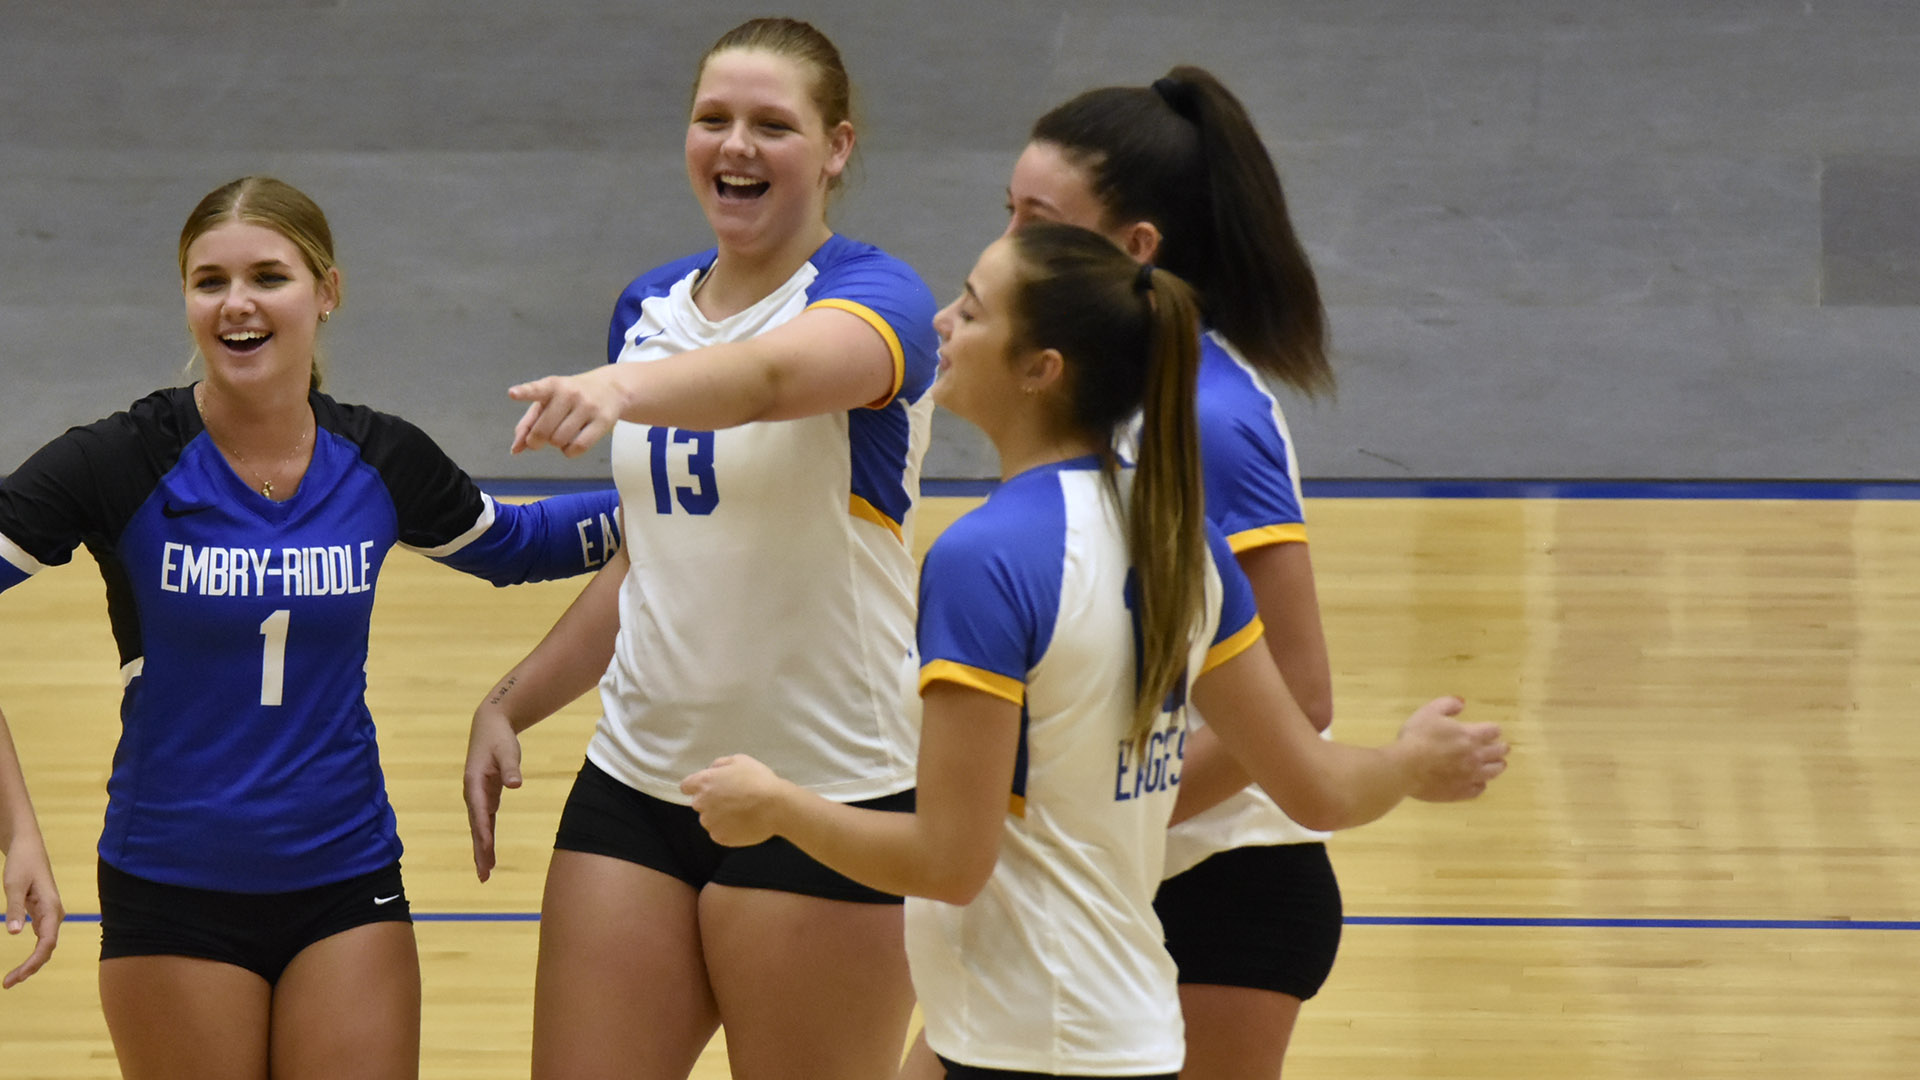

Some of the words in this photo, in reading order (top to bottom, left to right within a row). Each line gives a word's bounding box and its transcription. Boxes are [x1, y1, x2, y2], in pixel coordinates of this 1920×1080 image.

[647, 426, 720, 515] 13
[161, 540, 374, 596] EMBRY-RIDDLE
[259, 609, 291, 706] 1
